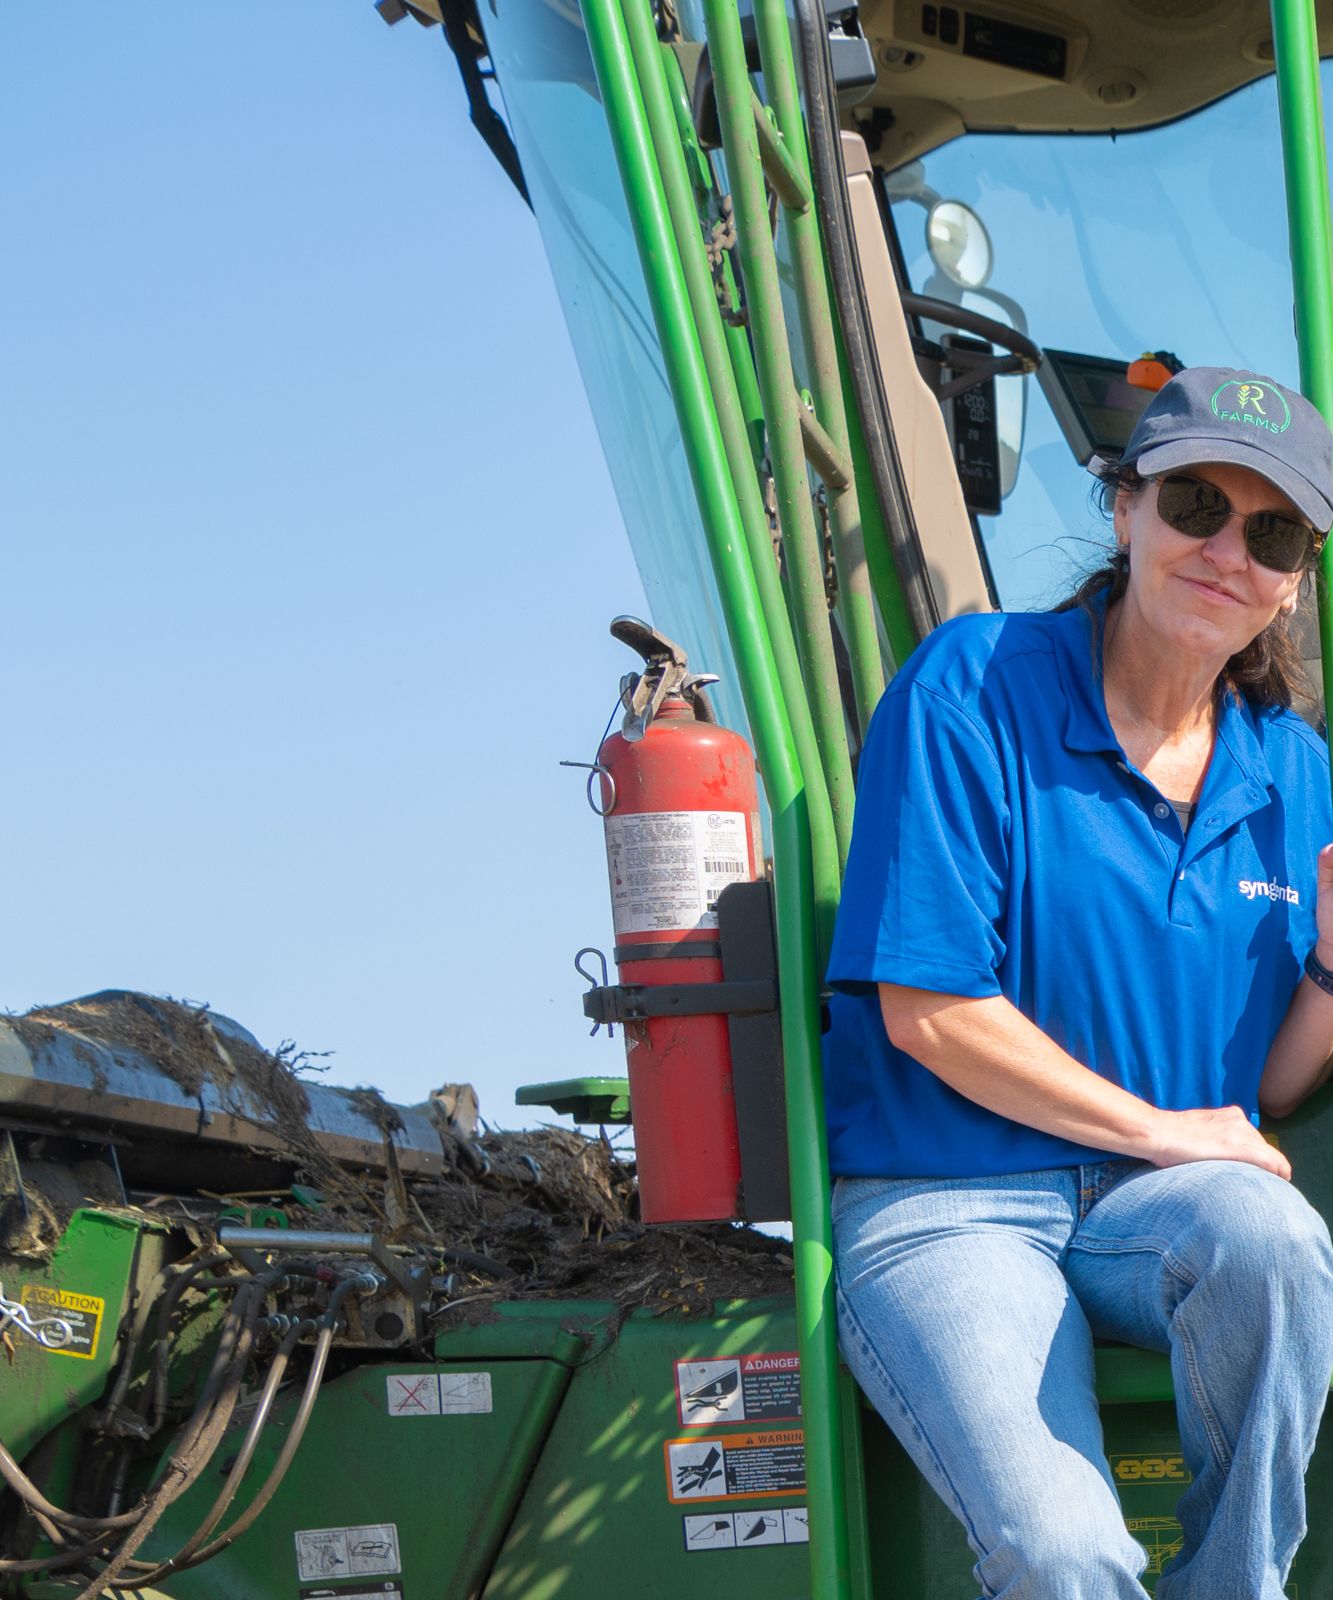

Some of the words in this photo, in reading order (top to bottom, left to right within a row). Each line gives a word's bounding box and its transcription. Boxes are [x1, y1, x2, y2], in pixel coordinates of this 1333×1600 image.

[1220, 411, 1280, 434] FARMS
[38, 1289, 100, 1310] CAUTION
[758, 1433, 802, 1444] WARNIN
